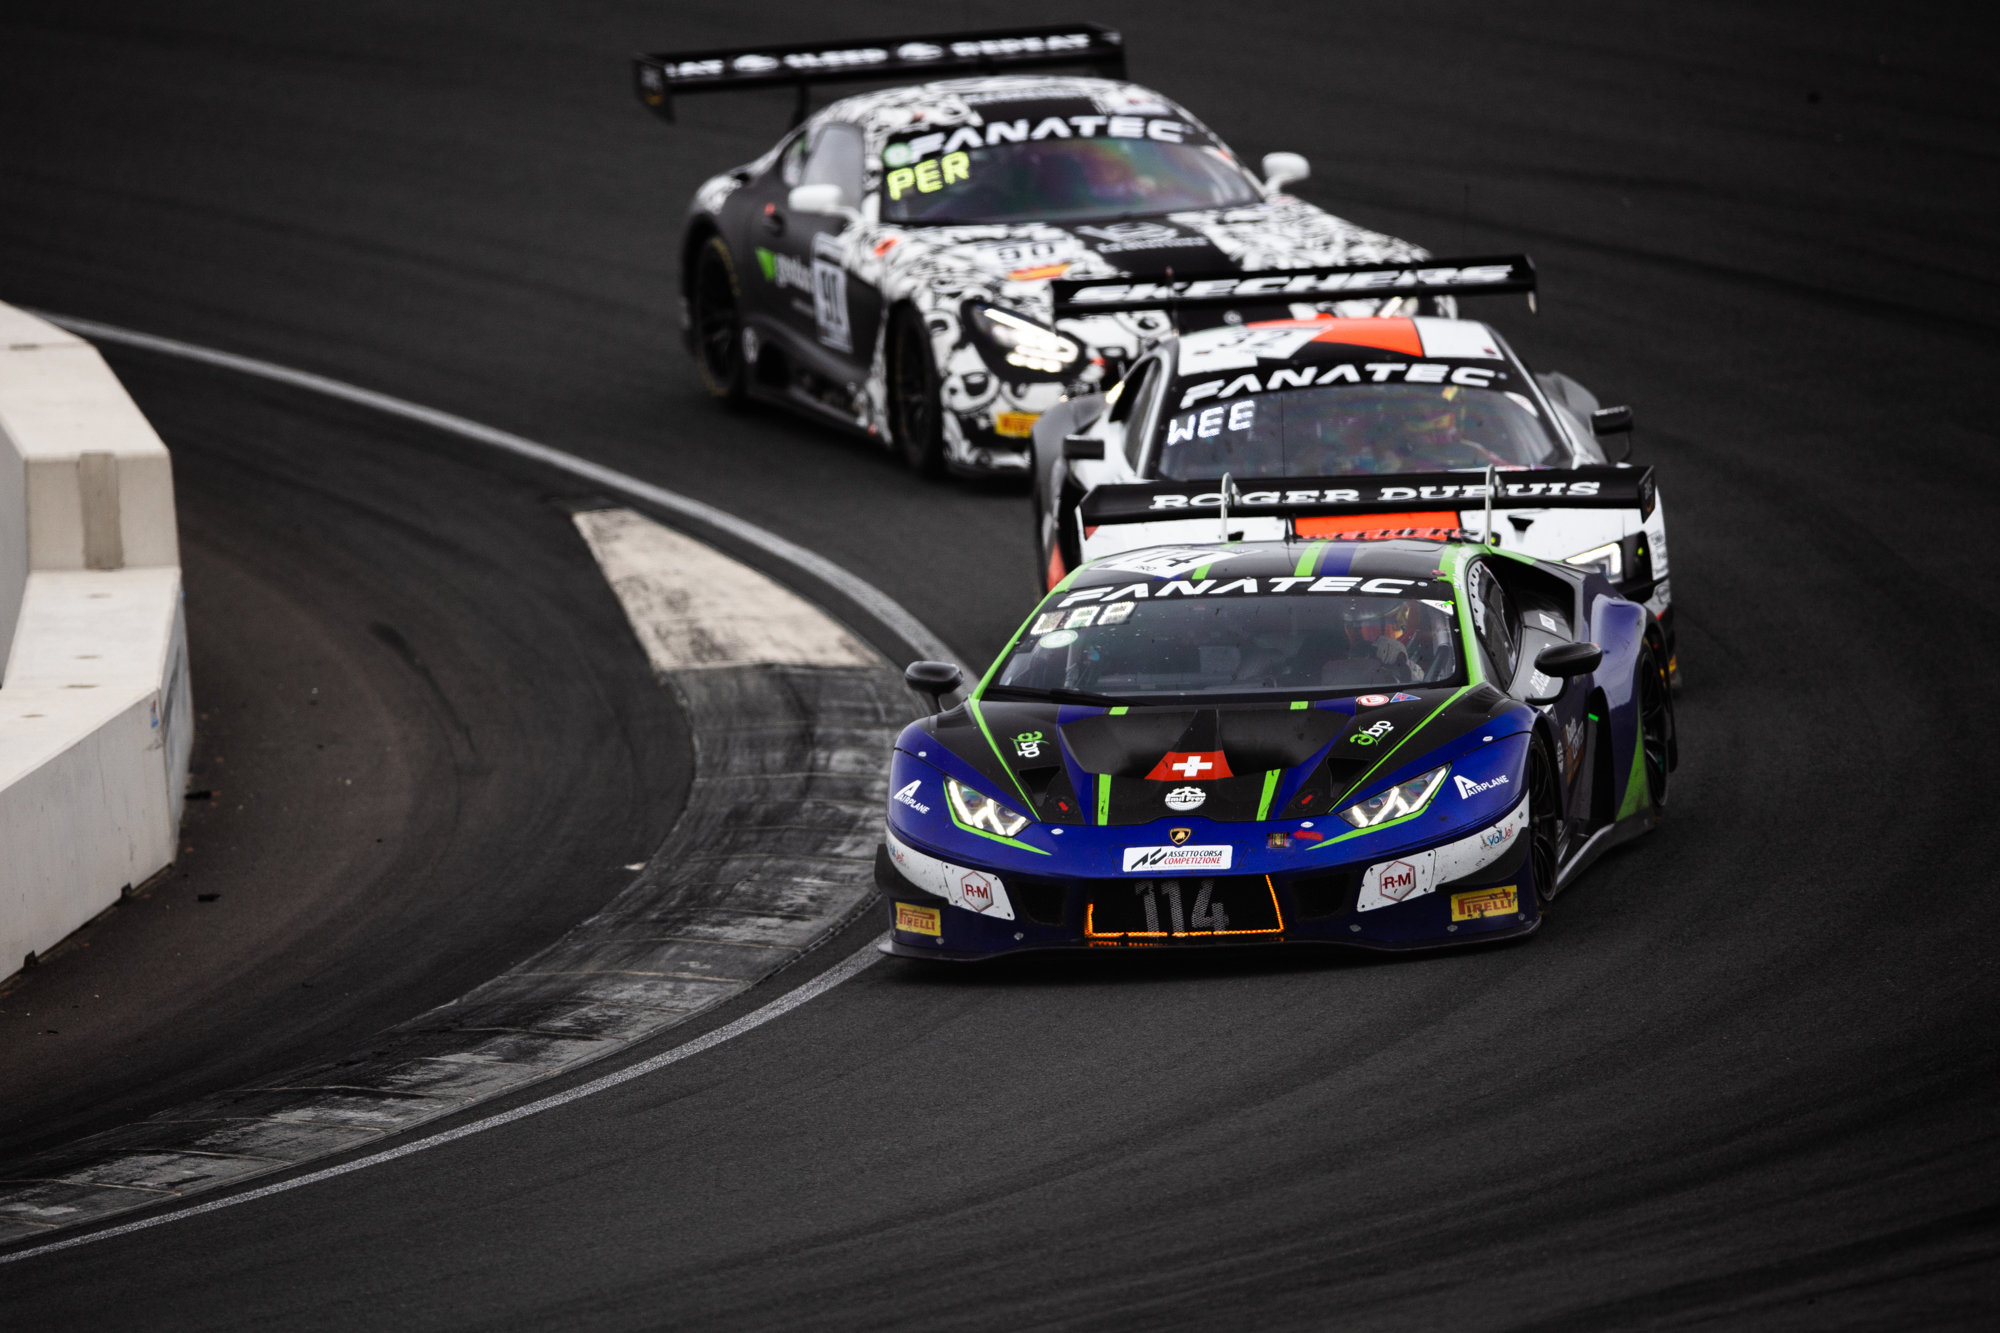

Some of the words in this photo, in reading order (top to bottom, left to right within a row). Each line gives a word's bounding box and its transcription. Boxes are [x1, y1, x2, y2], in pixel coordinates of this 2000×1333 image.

[907, 115, 1184, 164] FANATEC
[887, 151, 970, 200] PER
[1180, 362, 1495, 410] FANATEC
[1167, 400, 1255, 446] WEE
[1149, 488, 1360, 509] ROGER
[1056, 576, 1415, 608] FANATEC
[1030, 601, 1135, 635] LAP
[1466, 775, 1509, 797] AIRPLANE
[897, 793, 930, 814] AIRPLANE
[1164, 857, 1222, 865] COMPETIZIONE
[964, 883, 989, 900] R-M
[1384, 872, 1411, 889] R-M
[1135, 879, 1230, 937] 114
[1457, 891, 1512, 915] PIRELLI
[899, 907, 936, 930] PIRELLI
